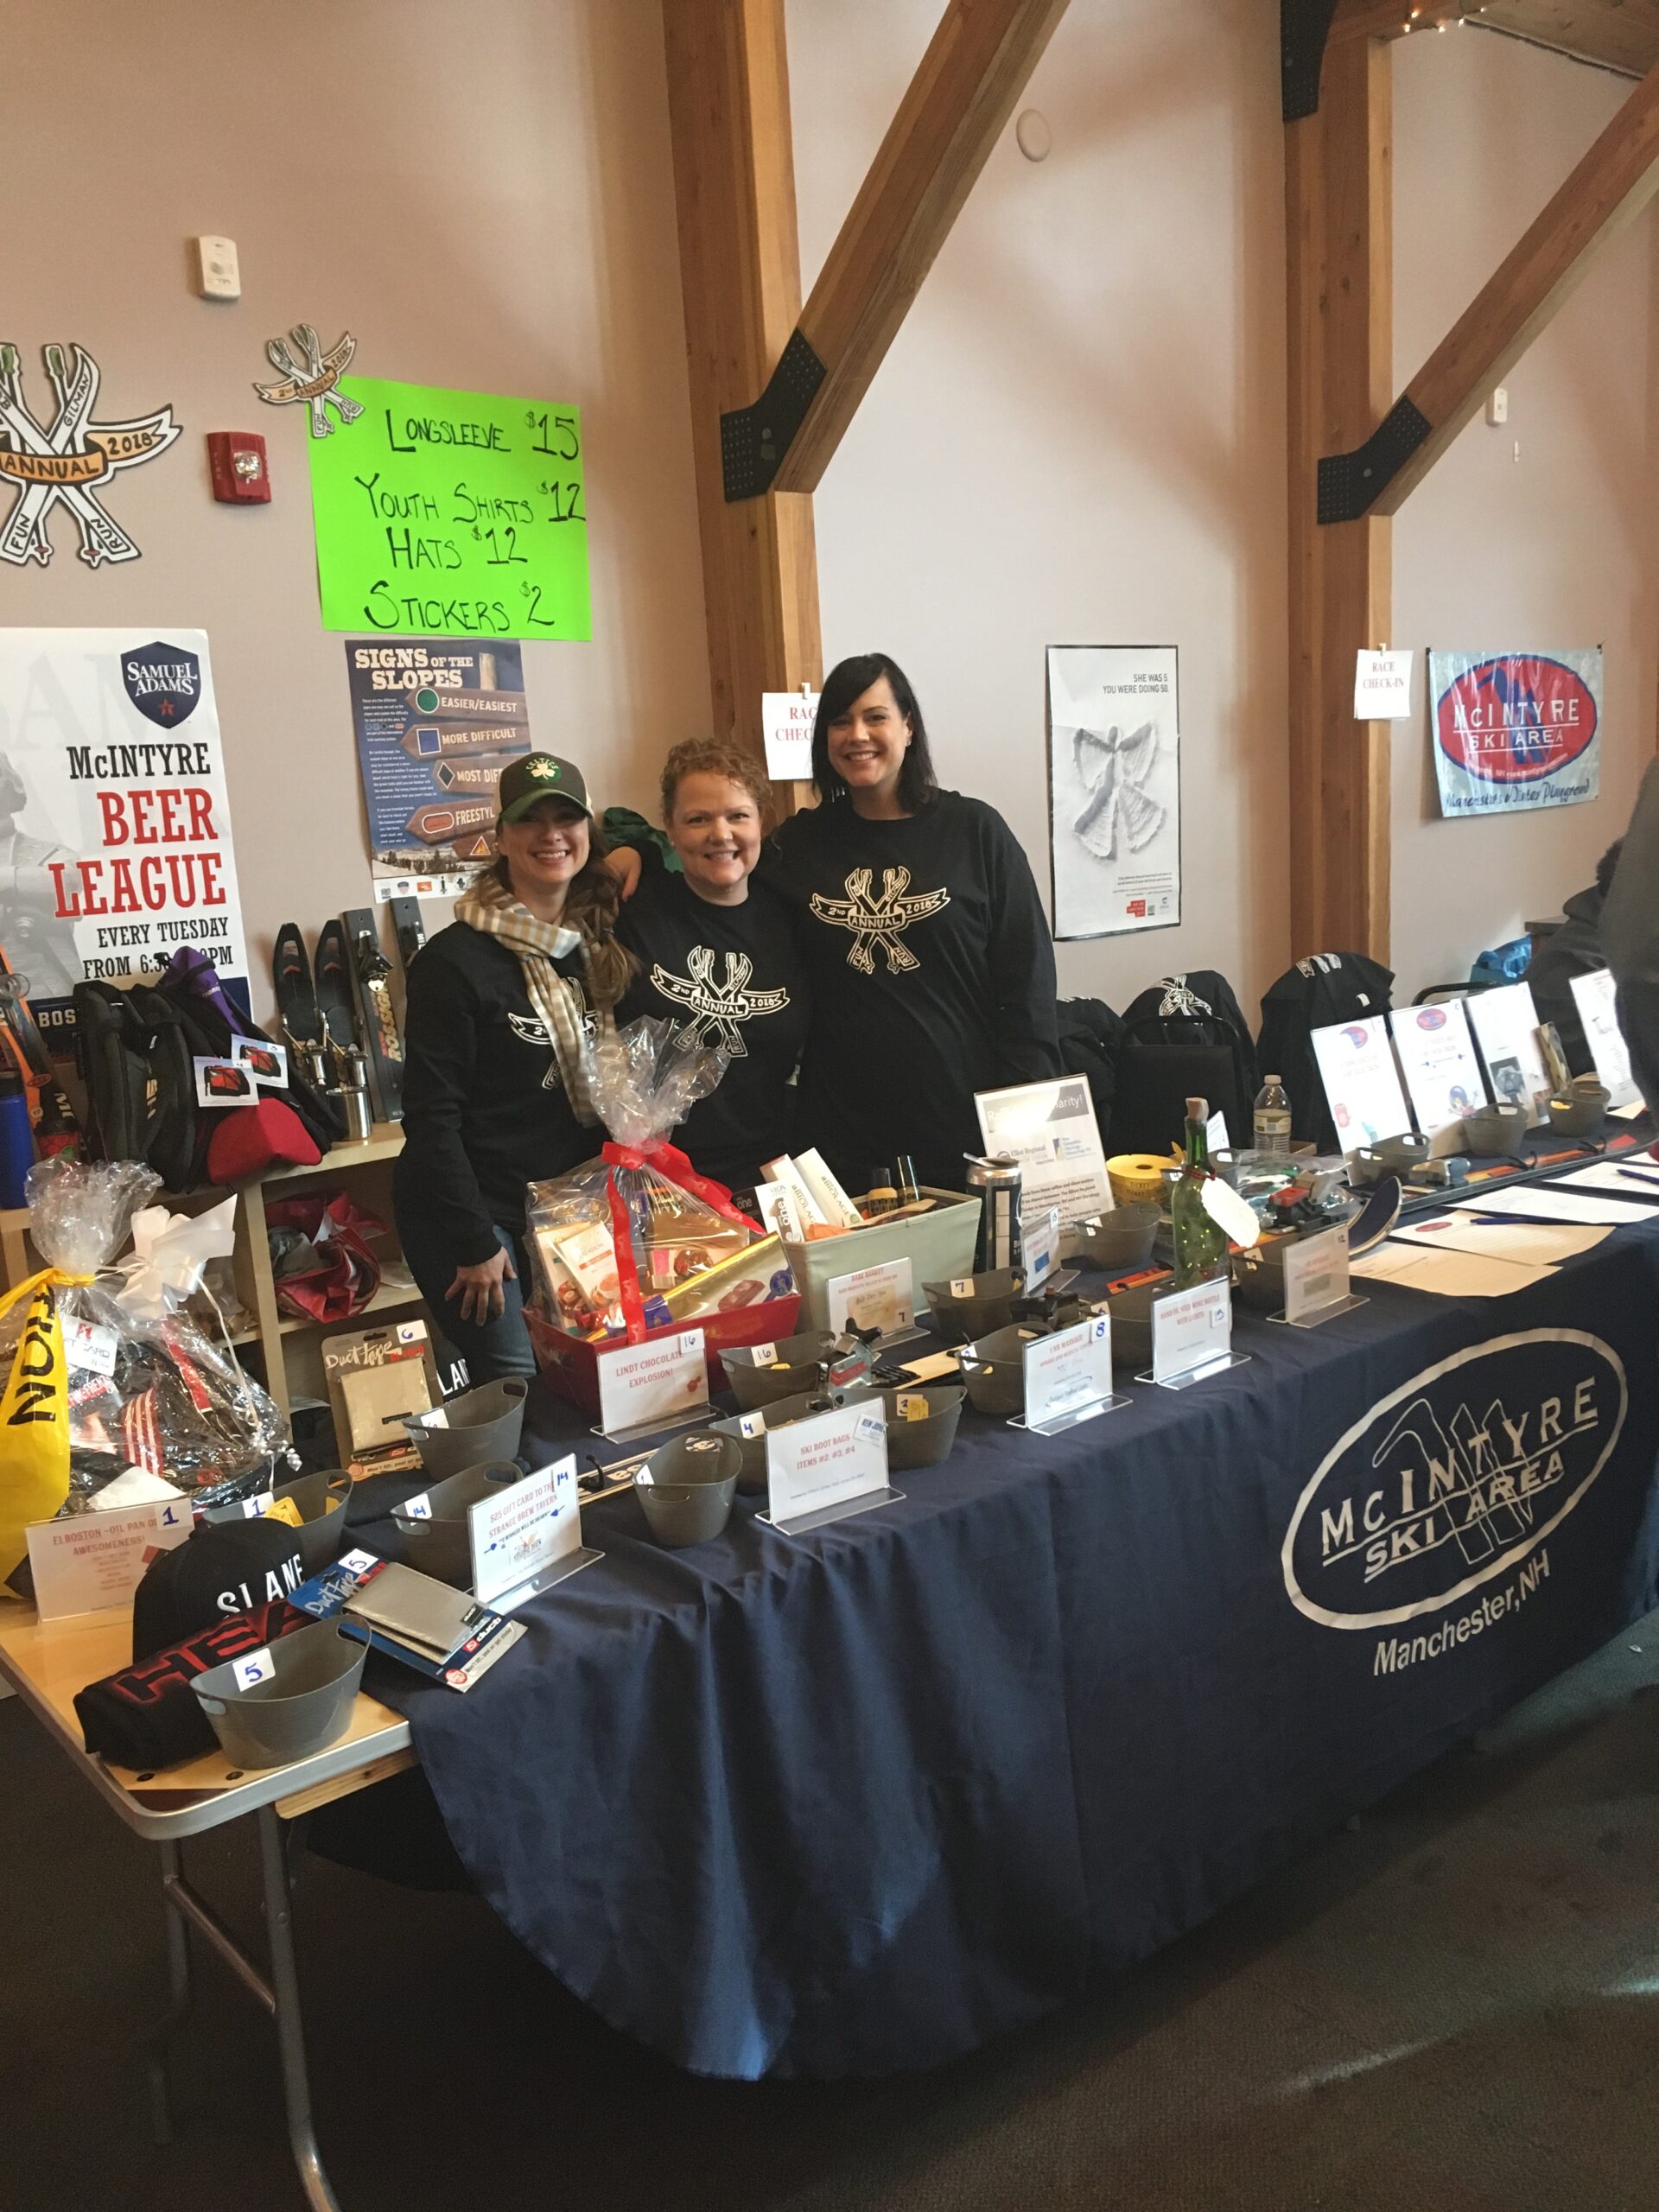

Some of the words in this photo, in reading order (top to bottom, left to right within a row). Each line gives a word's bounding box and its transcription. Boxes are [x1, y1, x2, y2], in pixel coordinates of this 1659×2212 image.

[300, 374, 334, 396] ANNUAL
[64, 374, 90, 427] GILMAN
[385, 410, 512, 453] LONGSLEEVE
[524, 410, 580, 461] $15
[5, 456, 99, 479] ANNUAL
[107, 432, 153, 454] 2018
[354, 473, 439, 520] YOUTH
[453, 483, 535, 524] SHIRTS
[537, 480, 587, 522] $12
[11, 513, 31, 550] FUN
[91, 518, 123, 549] RUN
[386, 527, 462, 569] HATS
[471, 525, 528, 565] $12
[364, 580, 510, 632] STICKERS
[518, 582, 555, 626] $2
[355, 648, 428, 669] SIGNS
[431, 657, 448, 667] OF
[448, 657, 474, 667] THE
[1372, 661, 1395, 672] RACE
[127, 661, 198, 683] SAMUEL
[372, 670, 463, 690] SLOPES
[1134, 673, 1147, 683] SHE
[1148, 673, 1163, 683] WAS
[135, 677, 194, 696] ADAMS
[1103, 685, 1116, 694] YOU
[1117, 685, 1137, 694] WERE
[1139, 684, 1160, 694] DOING
[1363, 677, 1404, 689] CHECK-IN
[442, 696, 517, 713] EASIER/EASIEST
[790, 707, 817, 720] RAC
[442, 733, 469, 745] MORE
[471, 728, 517, 743] DIFFICULT
[775, 728, 812, 741] CHEC
[1469, 735, 1505, 749] SKI
[1516, 728, 1563, 746] AREA
[67, 742, 211, 780] McINTYRE
[526, 757, 559, 769] CELTICS
[456, 771, 481, 782] MOST
[483, 768, 502, 783] DIFF
[97, 787, 219, 847] BEER
[48, 852, 227, 918] LEAGUE
[828, 907, 845, 916] 2ND
[851, 917, 900, 928] ANNUAL
[906, 900, 931, 914] 2018
[97, 924, 151, 949] EVERY
[156, 917, 229, 943] TUESDAY
[83, 956, 131, 980] FROM
[671, 984, 690, 995] 2ND
[694, 997, 743, 1014] ANNUAL
[750, 998, 774, 1007] 2018
[38, 1008, 77, 1027] BOS
[955, 1281, 964, 1294] 7
[899, 1313, 905, 1322] 7
[401, 1328, 414, 1338] 6
[1096, 1322, 1105, 1337] 8
[683, 1335, 696, 1347] 16
[326, 1350, 360, 1370] Duct
[359, 1340, 402, 1367] tape
[615, 1362, 639, 1377] LINDT
[639, 1351, 684, 1370] CHOCOLATE
[757, 1348, 772, 1359] 16
[629, 1368, 673, 1388] EXPLOSION!
[743, 1423, 753, 1434] 4
[801, 1446, 812, 1455] SKI
[814, 1440, 830, 1451] BOOT
[833, 1433, 850, 1445] BAGS
[797, 1458, 817, 1470] ITEMS
[845, 1446, 855, 1454] #4
[556, 1471, 569, 1486] 14
[162, 1506, 180, 1526] 1
[489, 1519, 517, 1538] STRANGE
[518, 1509, 534, 1522] BREW
[536, 1494, 558, 1512] TAVERN
[490, 1510, 503, 1523] $25
[503, 1503, 516, 1516] GIFT
[518, 1491, 534, 1508] CARD
[535, 1489, 543, 1497] TO
[1365, 1517, 1435, 1575] SKI
[1465, 1451, 1564, 1522] AREA
[65, 1529, 101, 1542] BOSTON
[128, 1520, 146, 1531] PAN
[73, 1535, 145, 1555] AWESOMENESS!
[348, 1559, 366, 1570] 5
[304, 1581, 335, 1614] Duct
[245, 1662, 264, 1683] 5
